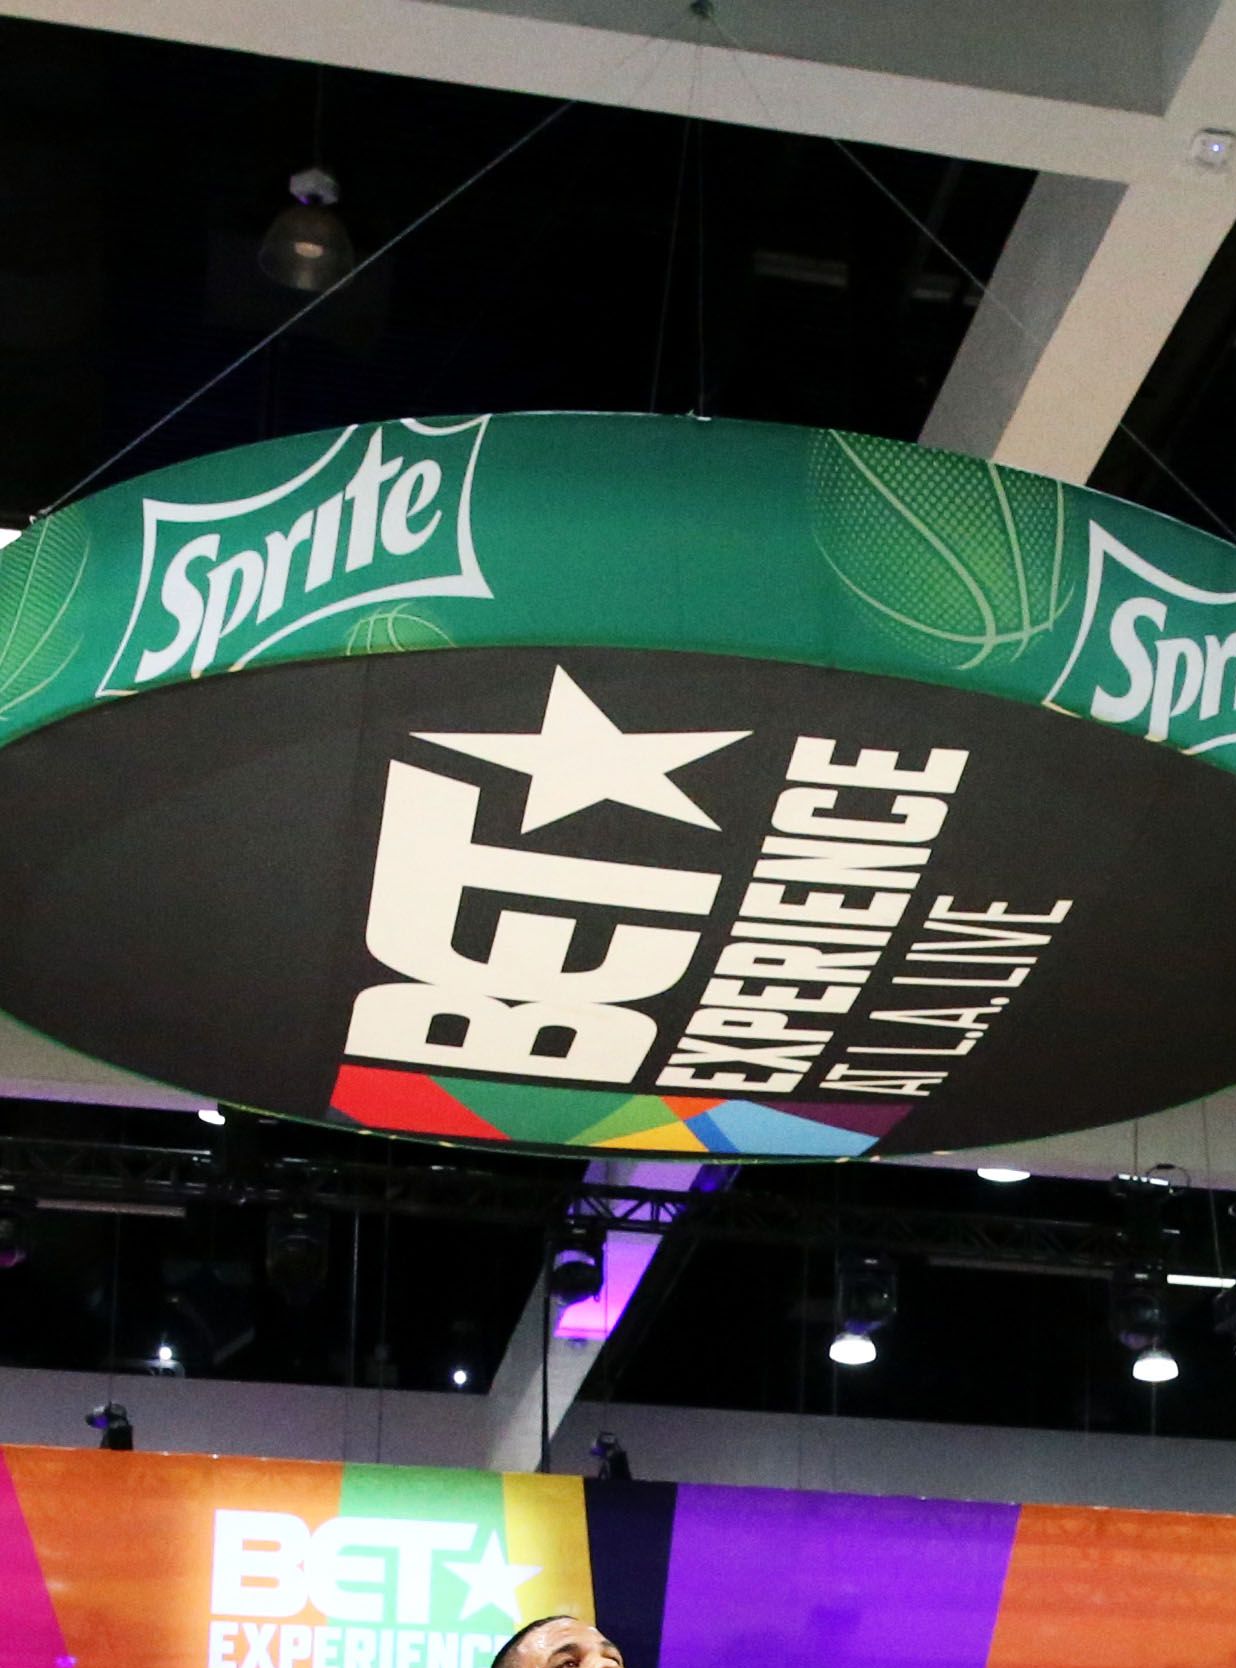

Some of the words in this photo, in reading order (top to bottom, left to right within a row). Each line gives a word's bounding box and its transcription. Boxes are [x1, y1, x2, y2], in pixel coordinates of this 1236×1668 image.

[135, 426, 443, 683] Sprite
[344, 758, 722, 1084] BET
[655, 736, 970, 1093] EXPERIENCE
[892, 895, 1074, 988] LIVE
[819, 1063, 949, 1097] AT
[846, 996, 1010, 1056] L.A.
[210, 1508, 478, 1625] BET
